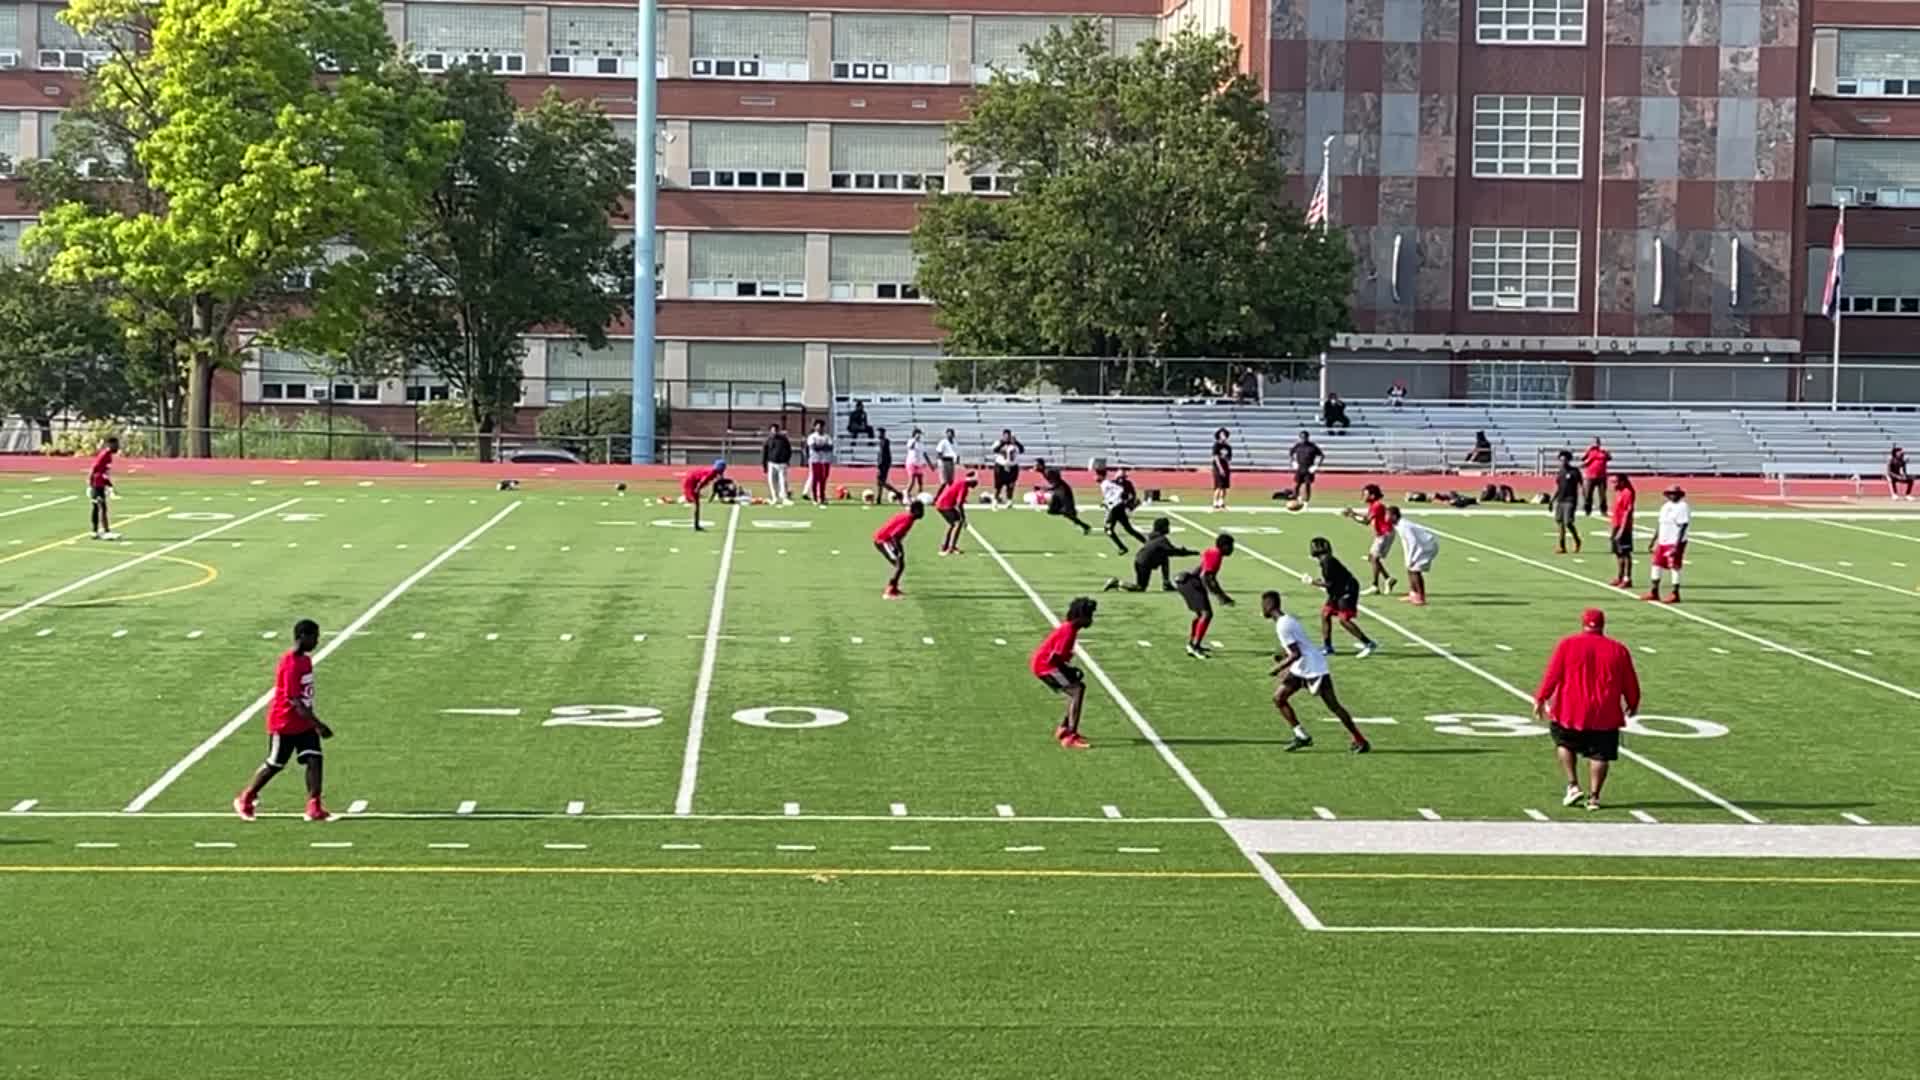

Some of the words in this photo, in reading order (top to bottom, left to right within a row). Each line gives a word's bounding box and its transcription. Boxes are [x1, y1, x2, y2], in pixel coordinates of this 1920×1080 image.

[1442, 339, 1546, 349] MAGNET
[1577, 340, 1638, 350] HIGH
[1668, 341, 1770, 351] SCHOOL
